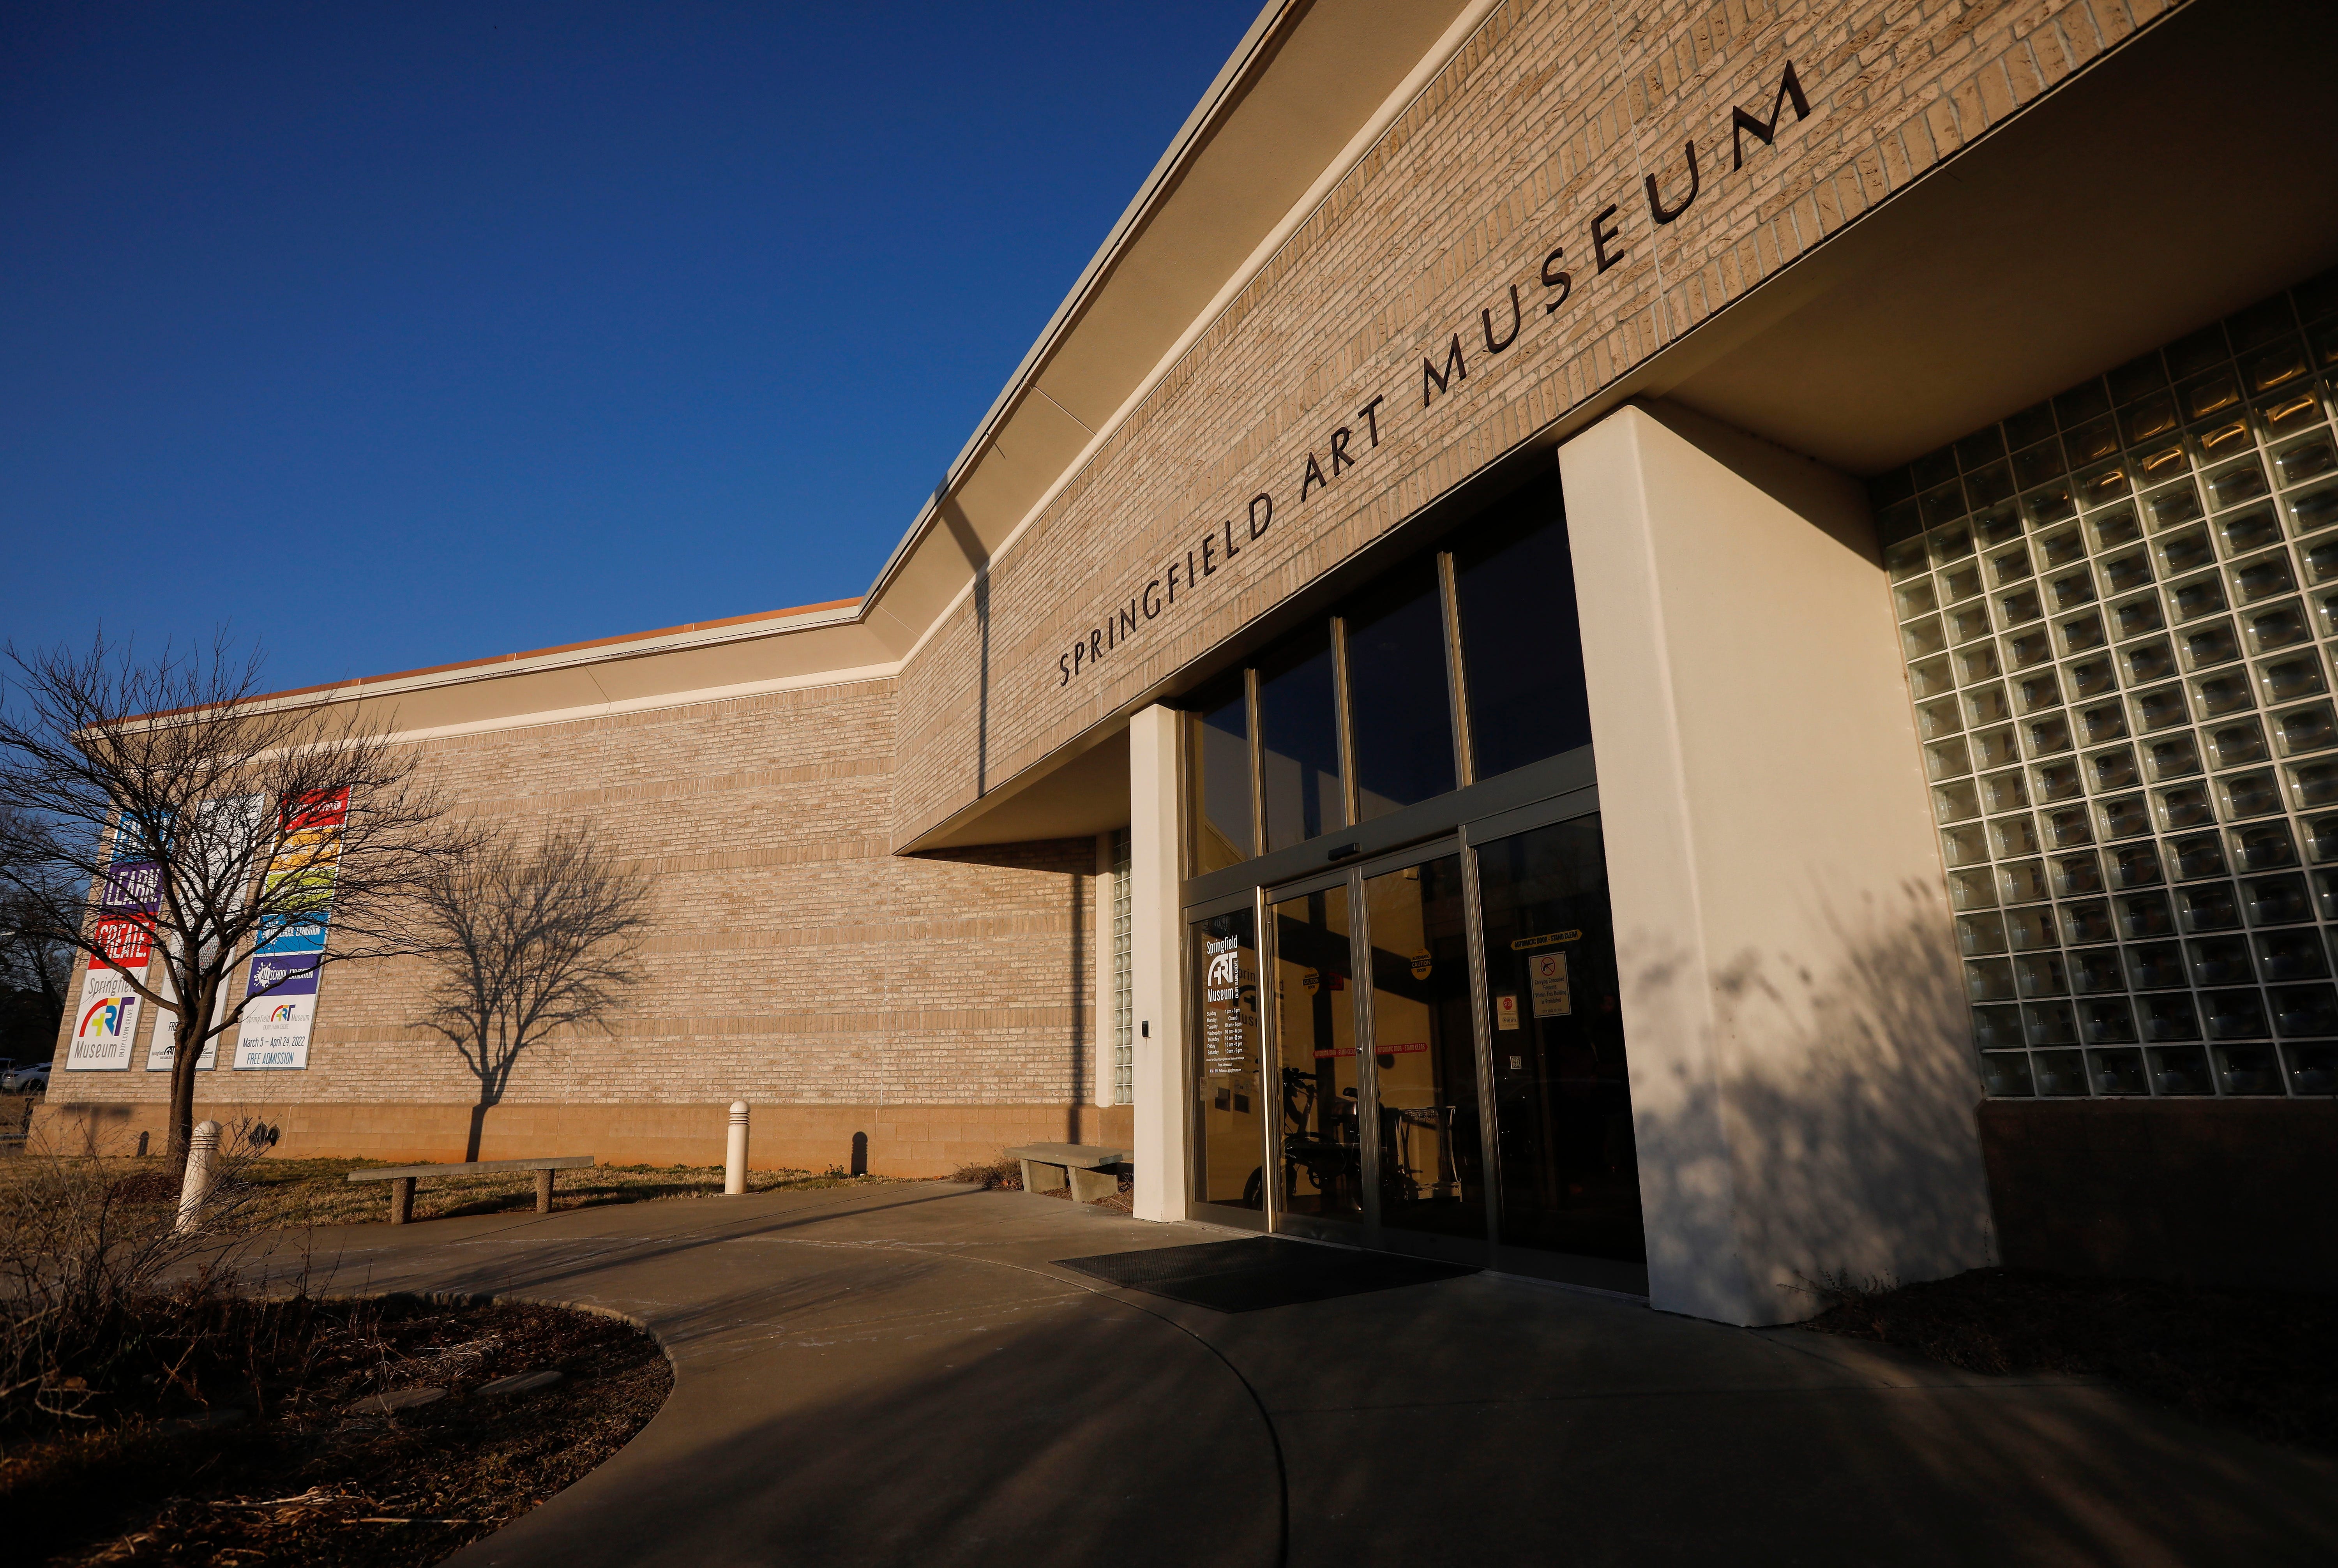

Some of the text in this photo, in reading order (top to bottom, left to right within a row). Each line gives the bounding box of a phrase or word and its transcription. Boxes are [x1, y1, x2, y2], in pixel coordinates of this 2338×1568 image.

[1060, 59, 1810, 687] SPRINGFIELD ART MUSEUM
[296, 925, 321, 936] EXHIBITION
[1207, 935, 1237, 956] Springfield
[1515, 940, 1536, 948] AUTOMATIC
[261, 969, 270, 980] ALL
[1208, 951, 1238, 986] ART
[1208, 988, 1233, 1002] Museum
[79, 997, 136, 1037] ART
[246, 1015, 270, 1024] Springfield
[270, 1004, 296, 1021] ART
[168, 1021, 178, 1031] FRE
[243, 1037, 259, 1047] March
[260, 1037, 264, 1047] 5
[270, 1037, 282, 1048] April
[292, 1036, 305, 1046] 2022
[74, 1041, 117, 1058] Museum
[247, 1052, 294, 1064] FREE ADMISSION
